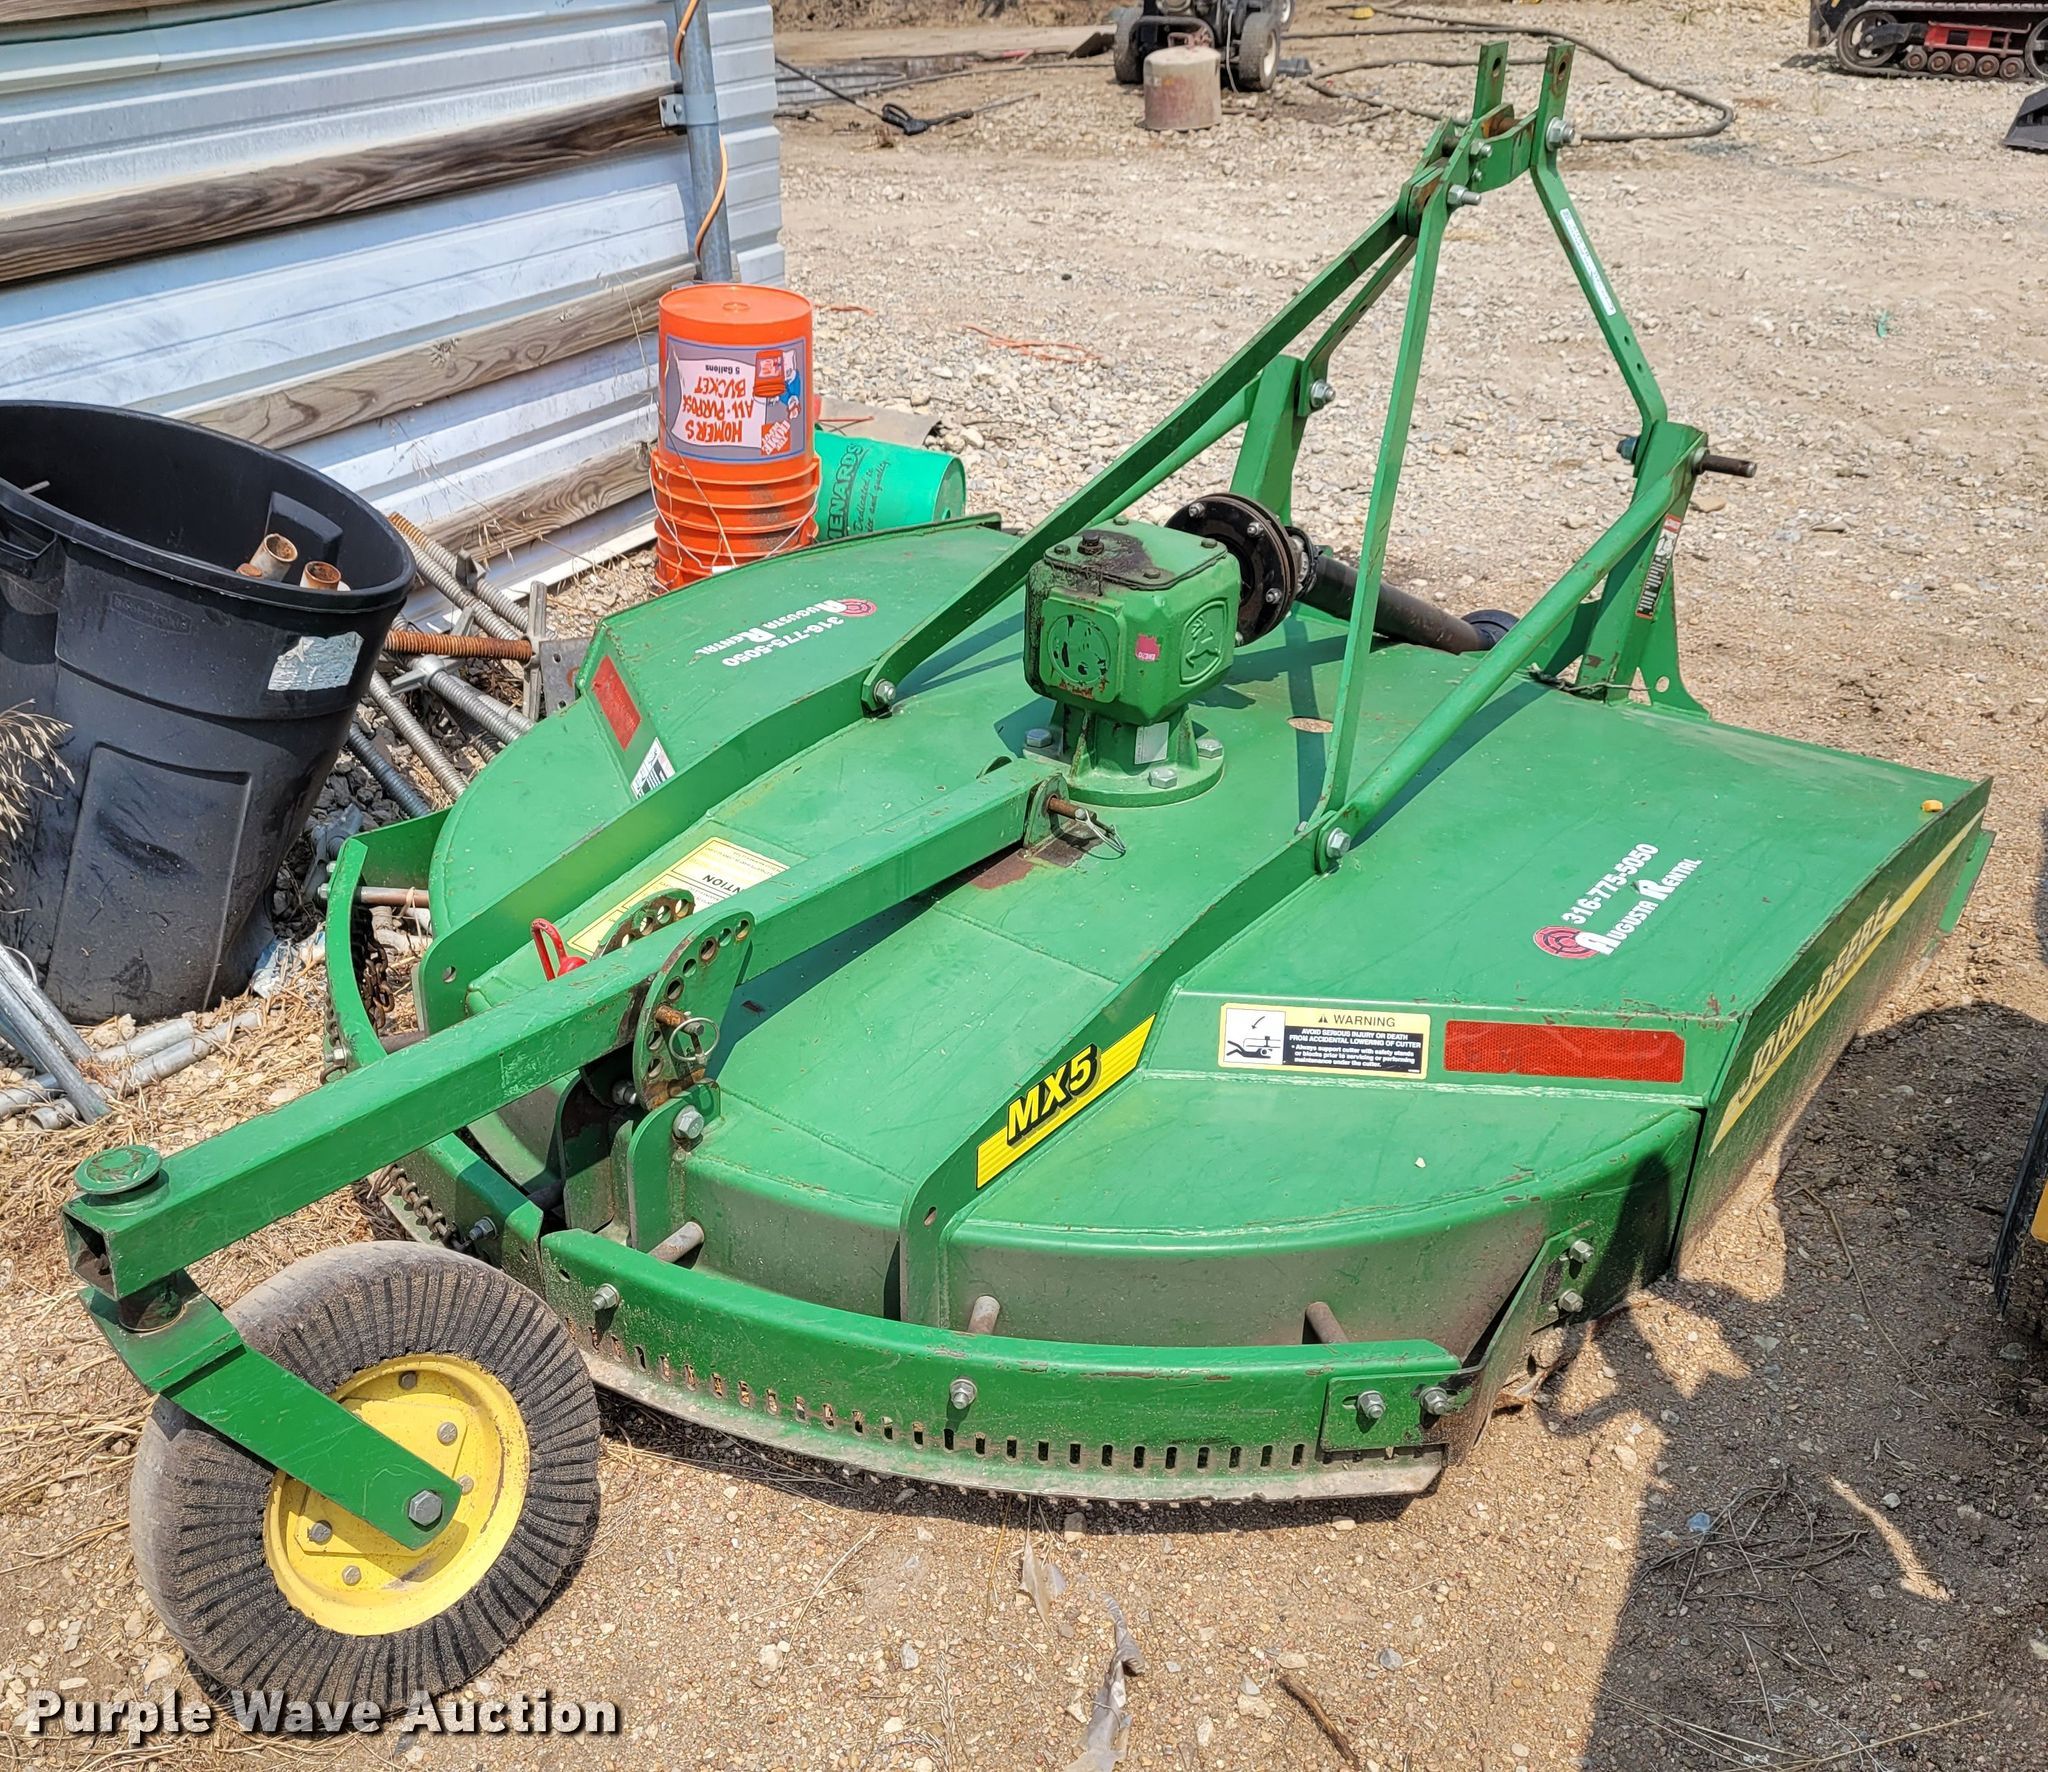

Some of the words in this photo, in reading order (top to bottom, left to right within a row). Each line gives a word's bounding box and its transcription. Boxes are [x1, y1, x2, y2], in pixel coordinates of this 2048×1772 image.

[705, 364, 733, 374] Gallons
[694, 376, 746, 398] BUCKET
[722, 616, 844, 667] 316-775-5050
[1561, 843, 1659, 925] 316-775-5050
[1333, 1014, 1396, 1027] WARNING
[1309, 1036, 1349, 1044] ACCIDENTAL
[1349, 1038, 1385, 1046] LOWERING
[1395, 1041, 1422, 1049] CUTTER
[1386, 1033, 1408, 1041] DEATH
[1007, 1044, 1098, 1145] MX5
